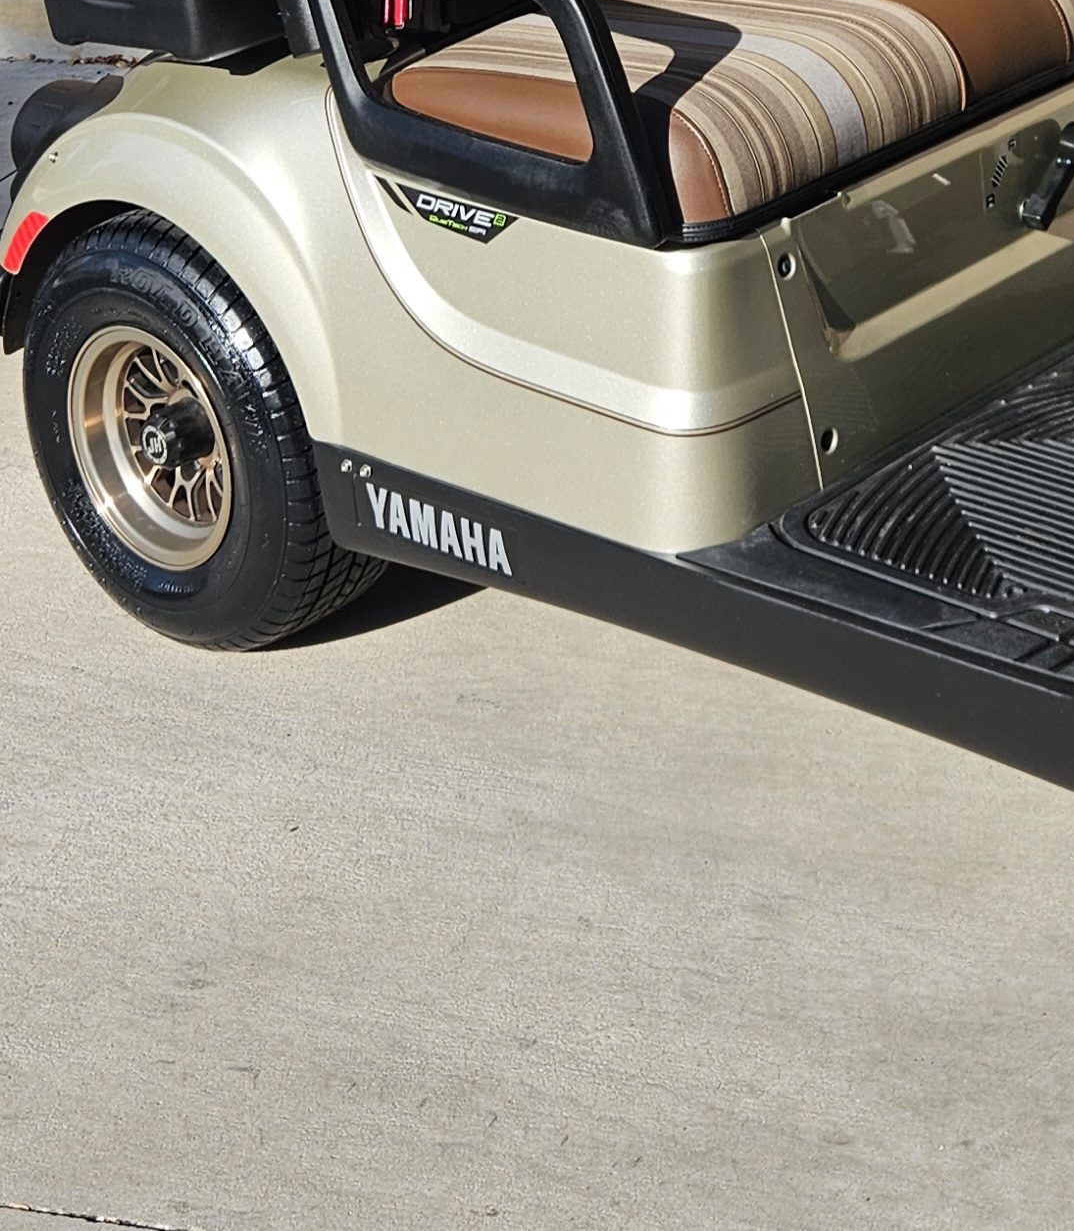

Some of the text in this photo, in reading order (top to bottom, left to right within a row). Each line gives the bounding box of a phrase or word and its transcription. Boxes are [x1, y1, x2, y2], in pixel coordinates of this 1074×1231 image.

[1007, 138, 1016, 151] F
[986, 193, 996, 208] R
[110, 268, 200, 328] ROAD
[366, 482, 513, 577] YAMAHA
